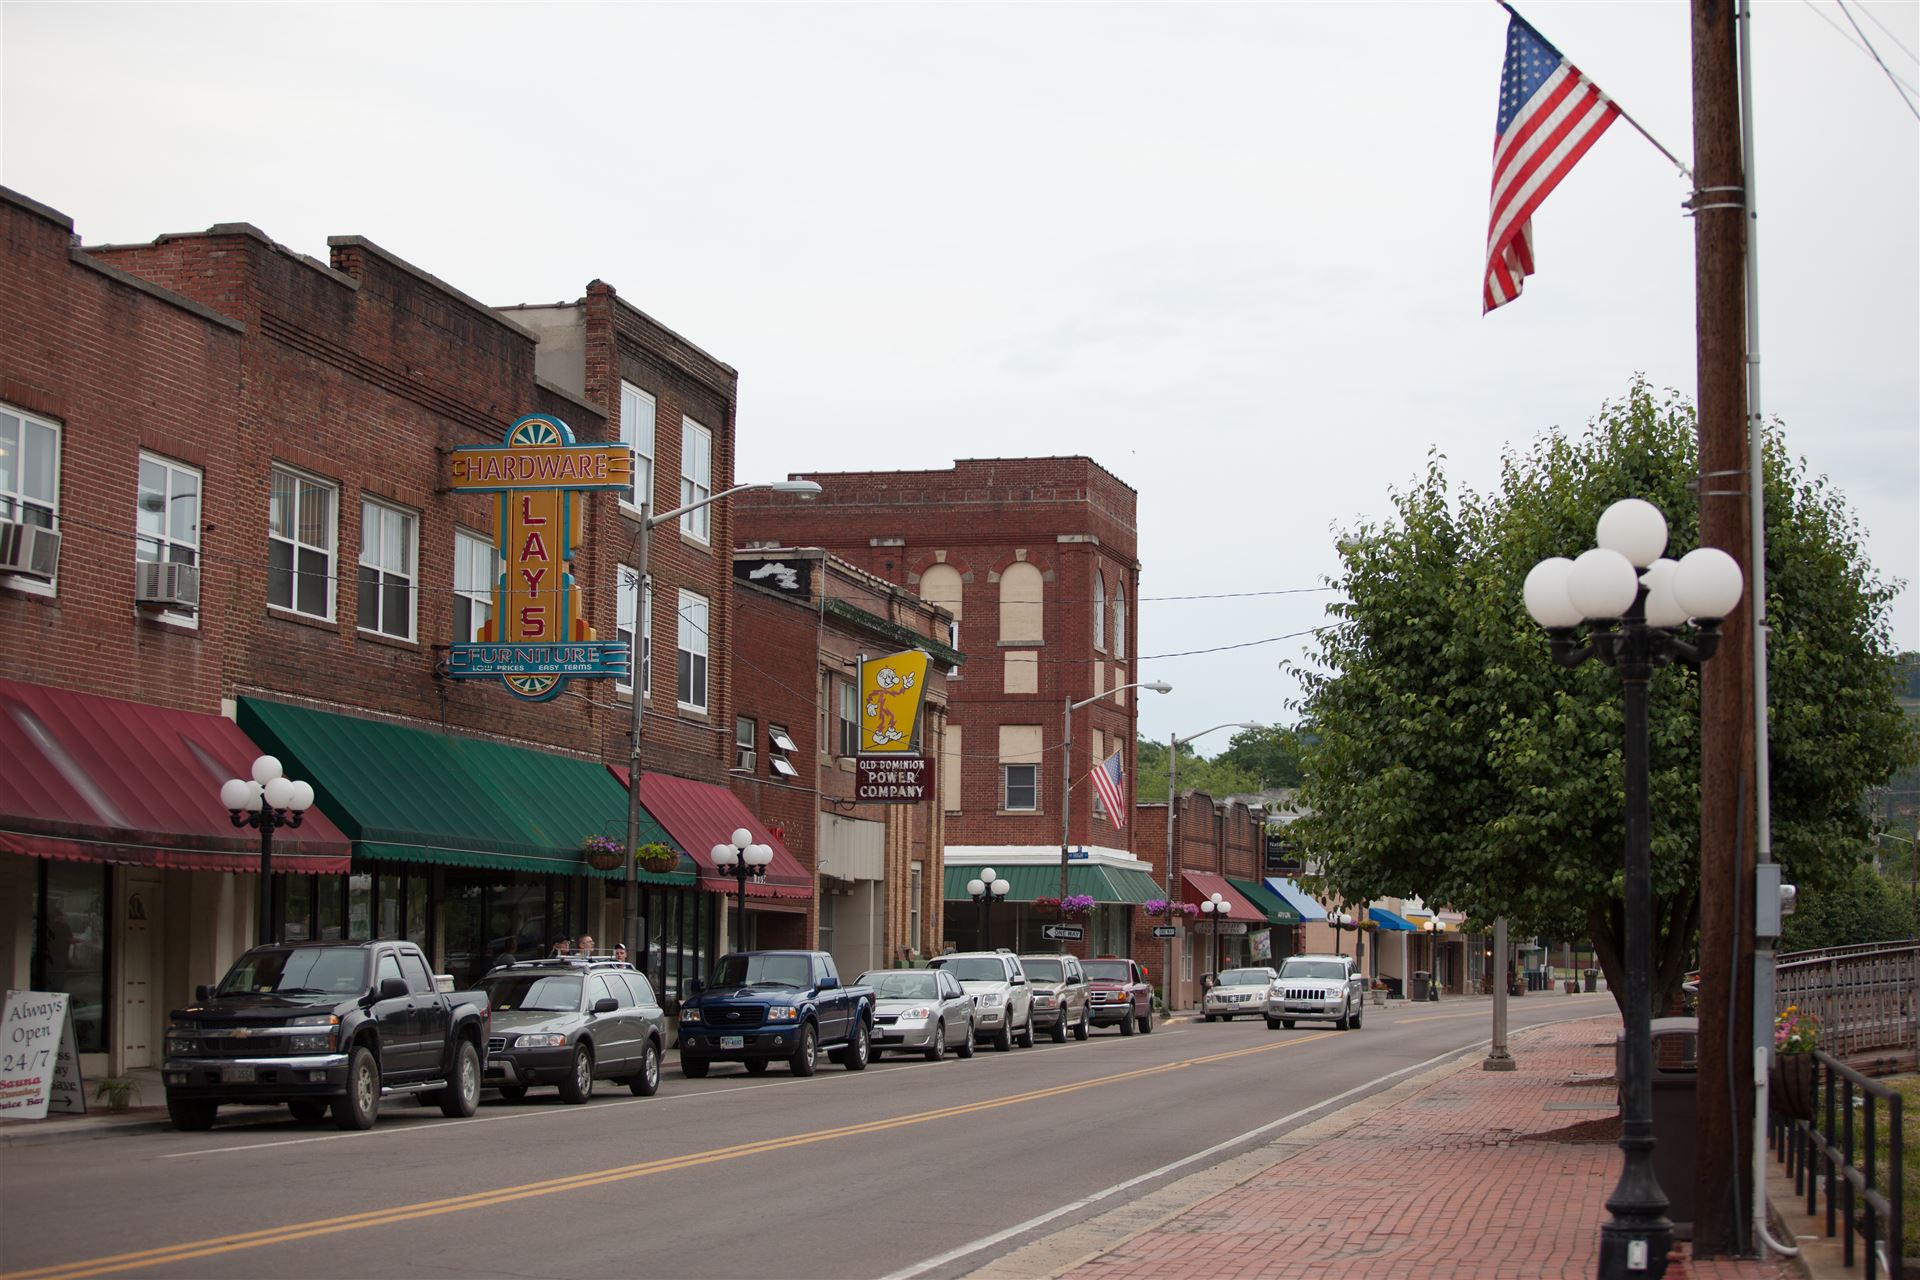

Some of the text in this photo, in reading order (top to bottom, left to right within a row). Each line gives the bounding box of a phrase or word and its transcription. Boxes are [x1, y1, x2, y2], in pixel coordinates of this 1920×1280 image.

[466, 454, 607, 481] HARDWARE
[520, 496, 549, 638] LAYS
[468, 647, 600, 665] FURNITURE
[860, 760, 925, 770] OLD DOMINION
[868, 771, 917, 783] POWER
[859, 785, 925, 798] COMPANY
[1055, 929, 1081, 938] ONE WAY
[9, 1000, 63, 1022] Always
[12, 1025, 52, 1047] Open
[3, 1050, 51, 1072] 24/7
[0, 1077, 42, 1089] Sauna
[26, 1098, 45, 1106] Bar
